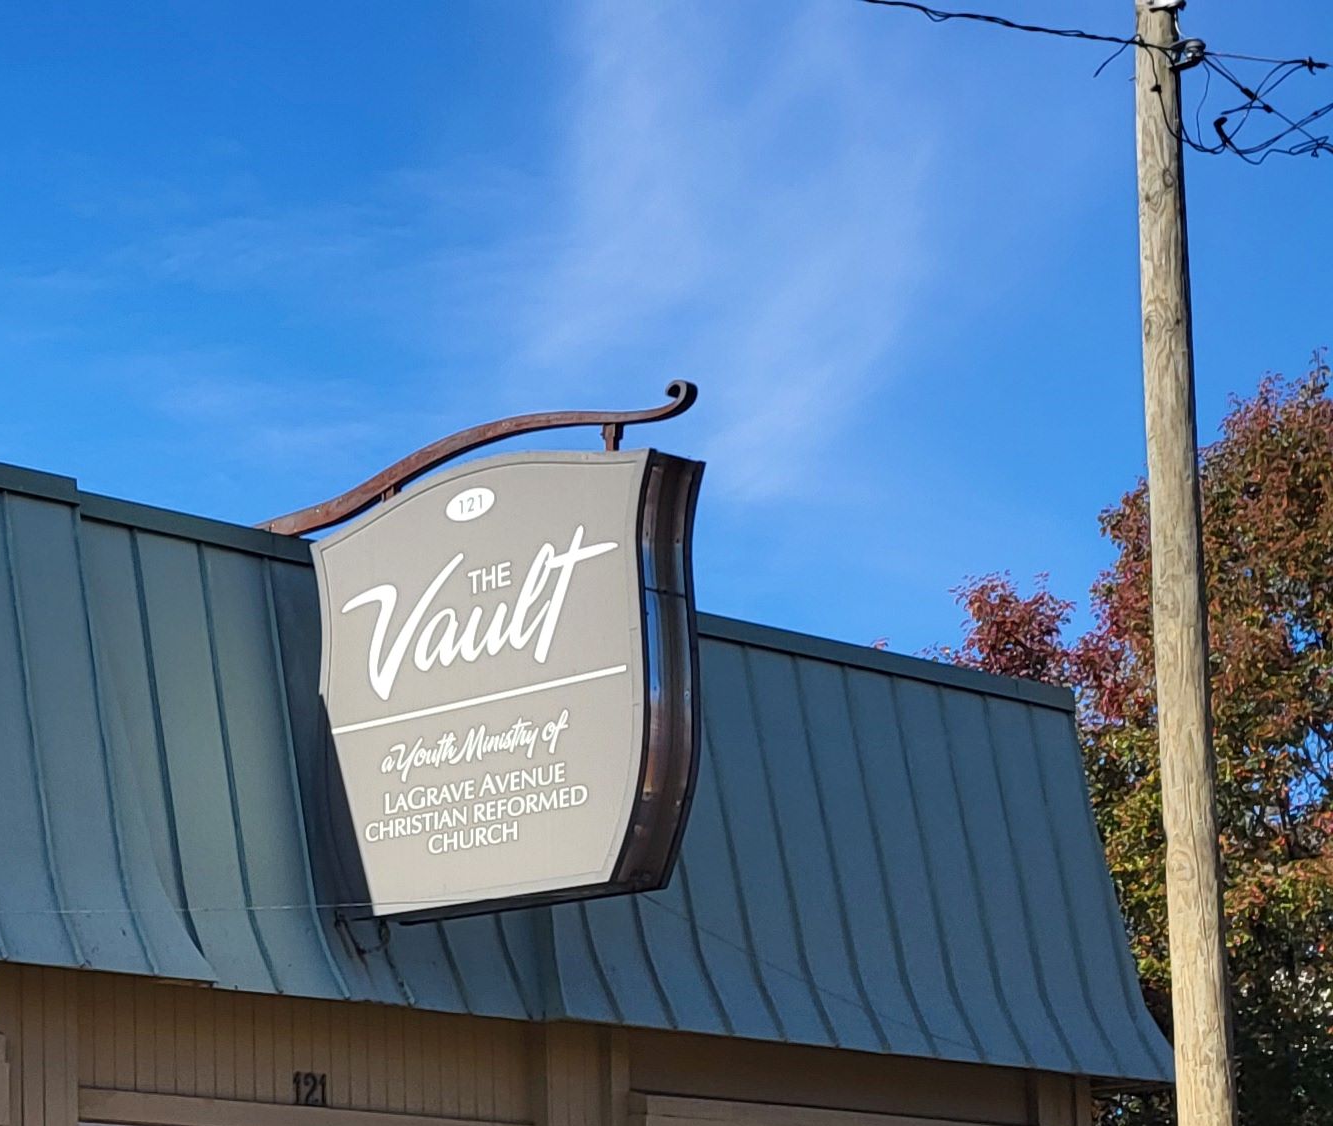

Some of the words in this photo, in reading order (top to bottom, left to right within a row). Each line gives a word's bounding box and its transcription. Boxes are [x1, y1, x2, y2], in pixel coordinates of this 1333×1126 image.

[459, 494, 483, 515] 121
[467, 561, 512, 595] THE
[341, 525, 620, 701] Vault
[381, 754, 396, 773] a
[390, 732, 458, 782] Youth
[449, 717, 540, 764] Ministry
[541, 708, 570, 754] of
[479, 762, 566, 797] AVENUE
[365, 806, 468, 842] CHRISTIAN
[473, 785, 589, 823] REFORMED
[428, 821, 519, 854] CHURCH
[293, 1071, 326, 1106] 121
